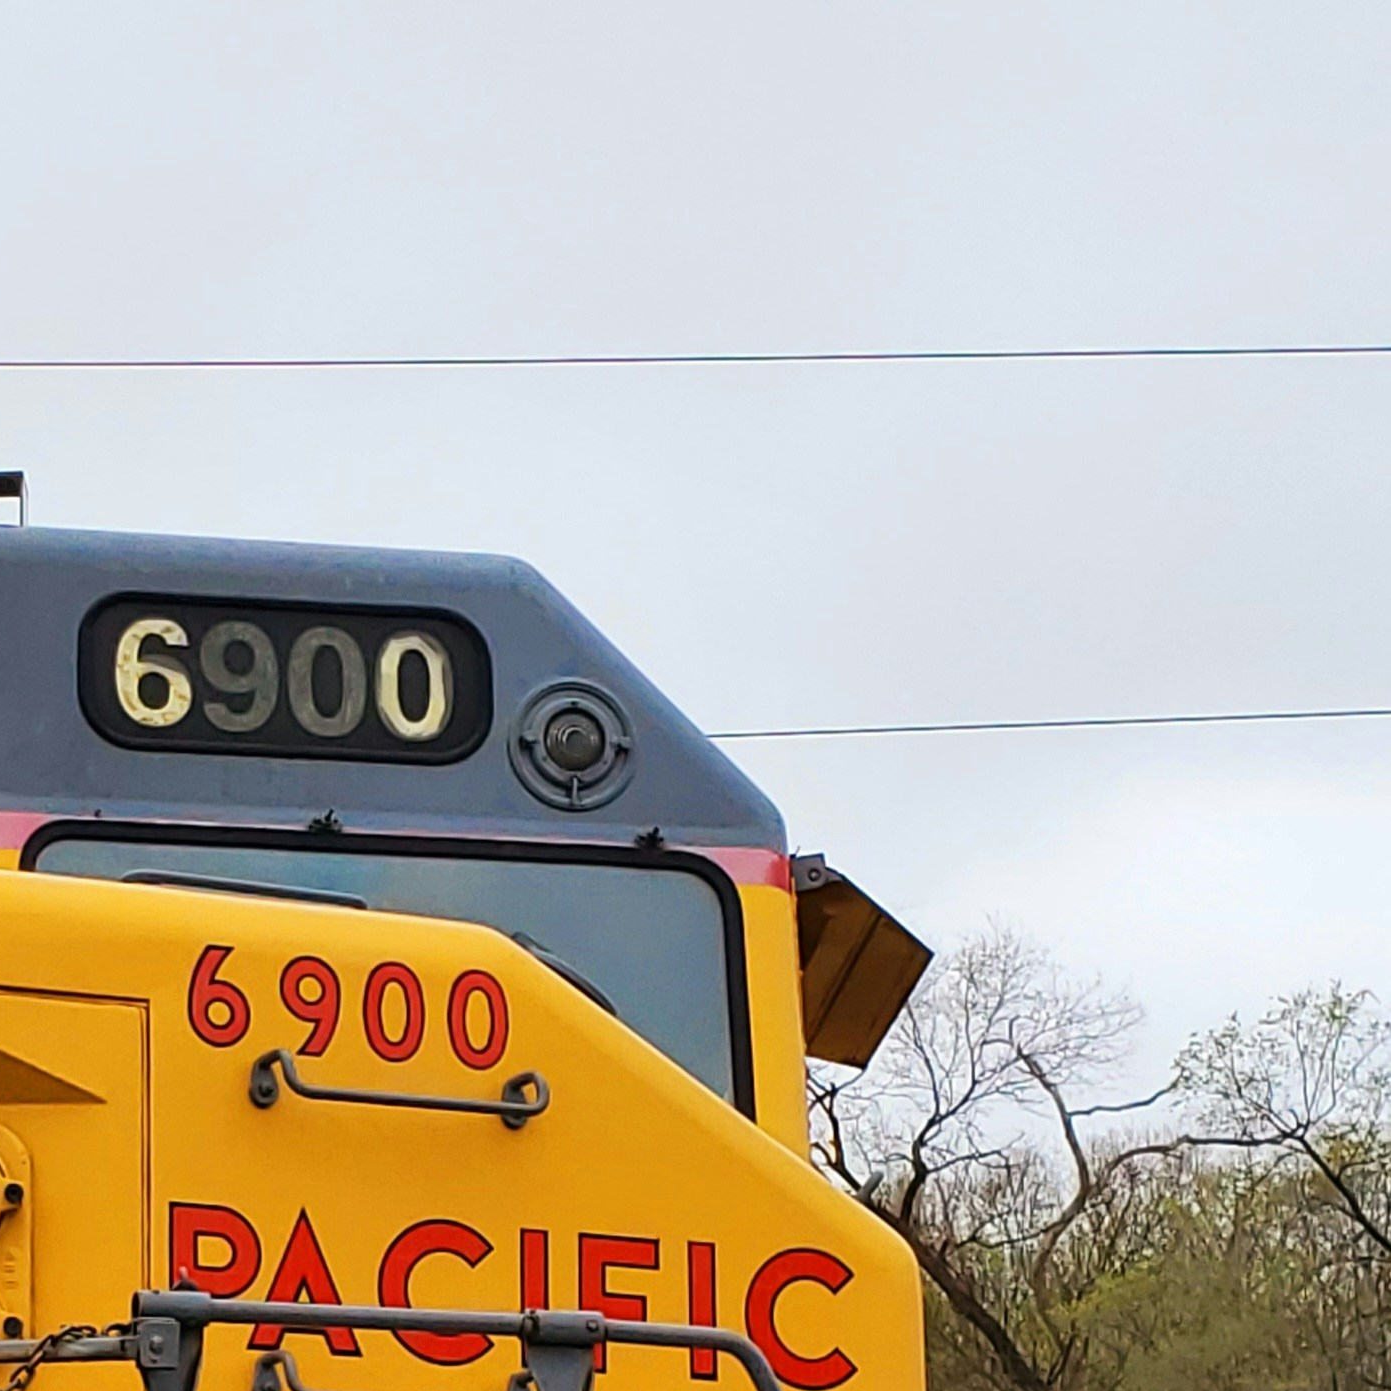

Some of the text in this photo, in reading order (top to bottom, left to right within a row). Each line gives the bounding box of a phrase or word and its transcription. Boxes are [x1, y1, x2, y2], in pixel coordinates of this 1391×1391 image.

[113, 617, 456, 739] 6900
[187, 944, 509, 1071] 6900
[168, 1201, 858, 1390] PACIFIC
